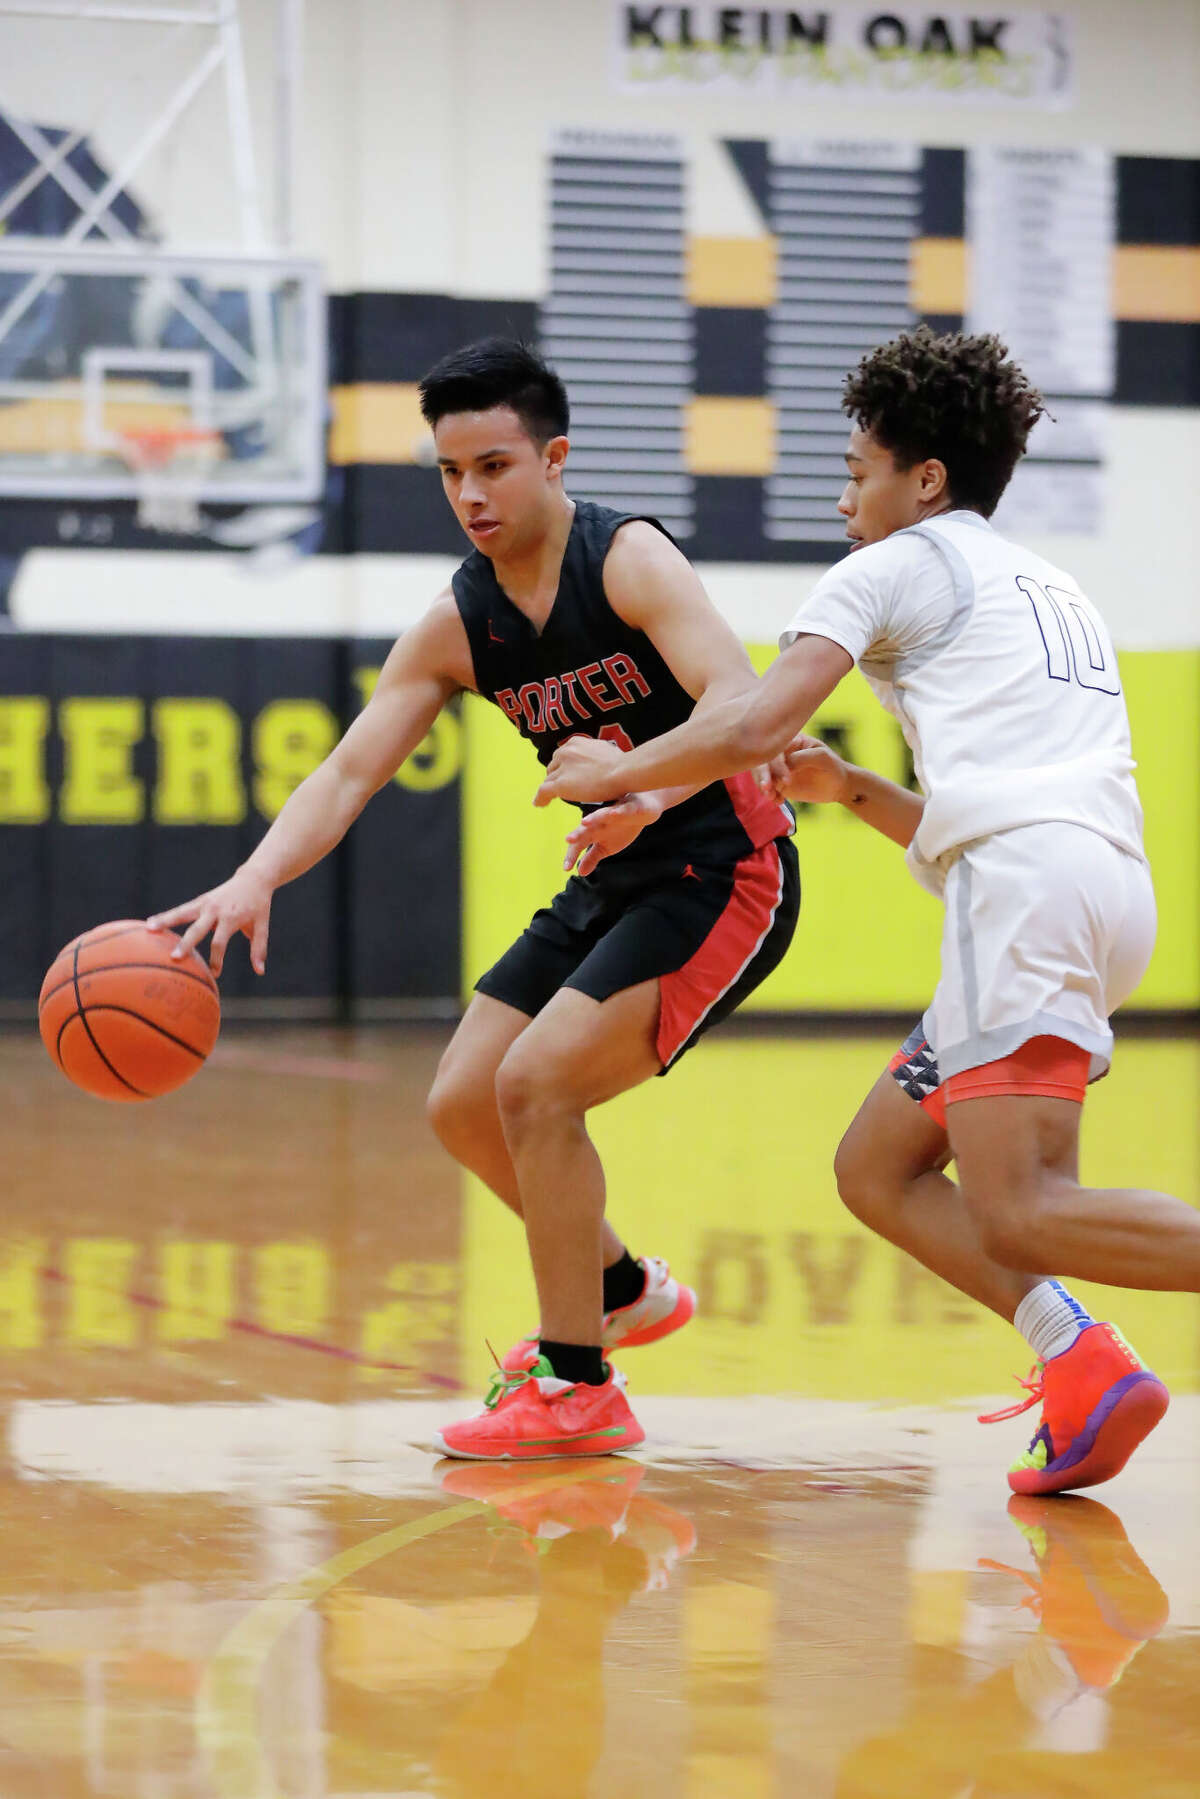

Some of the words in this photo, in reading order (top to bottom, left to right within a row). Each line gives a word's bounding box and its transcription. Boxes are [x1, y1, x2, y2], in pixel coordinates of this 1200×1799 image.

[624, 5, 829, 54] KLEIN
[862, 14, 1010, 63] OAK
[1015, 574, 1121, 696] 10
[493, 652, 652, 734] PORTER
